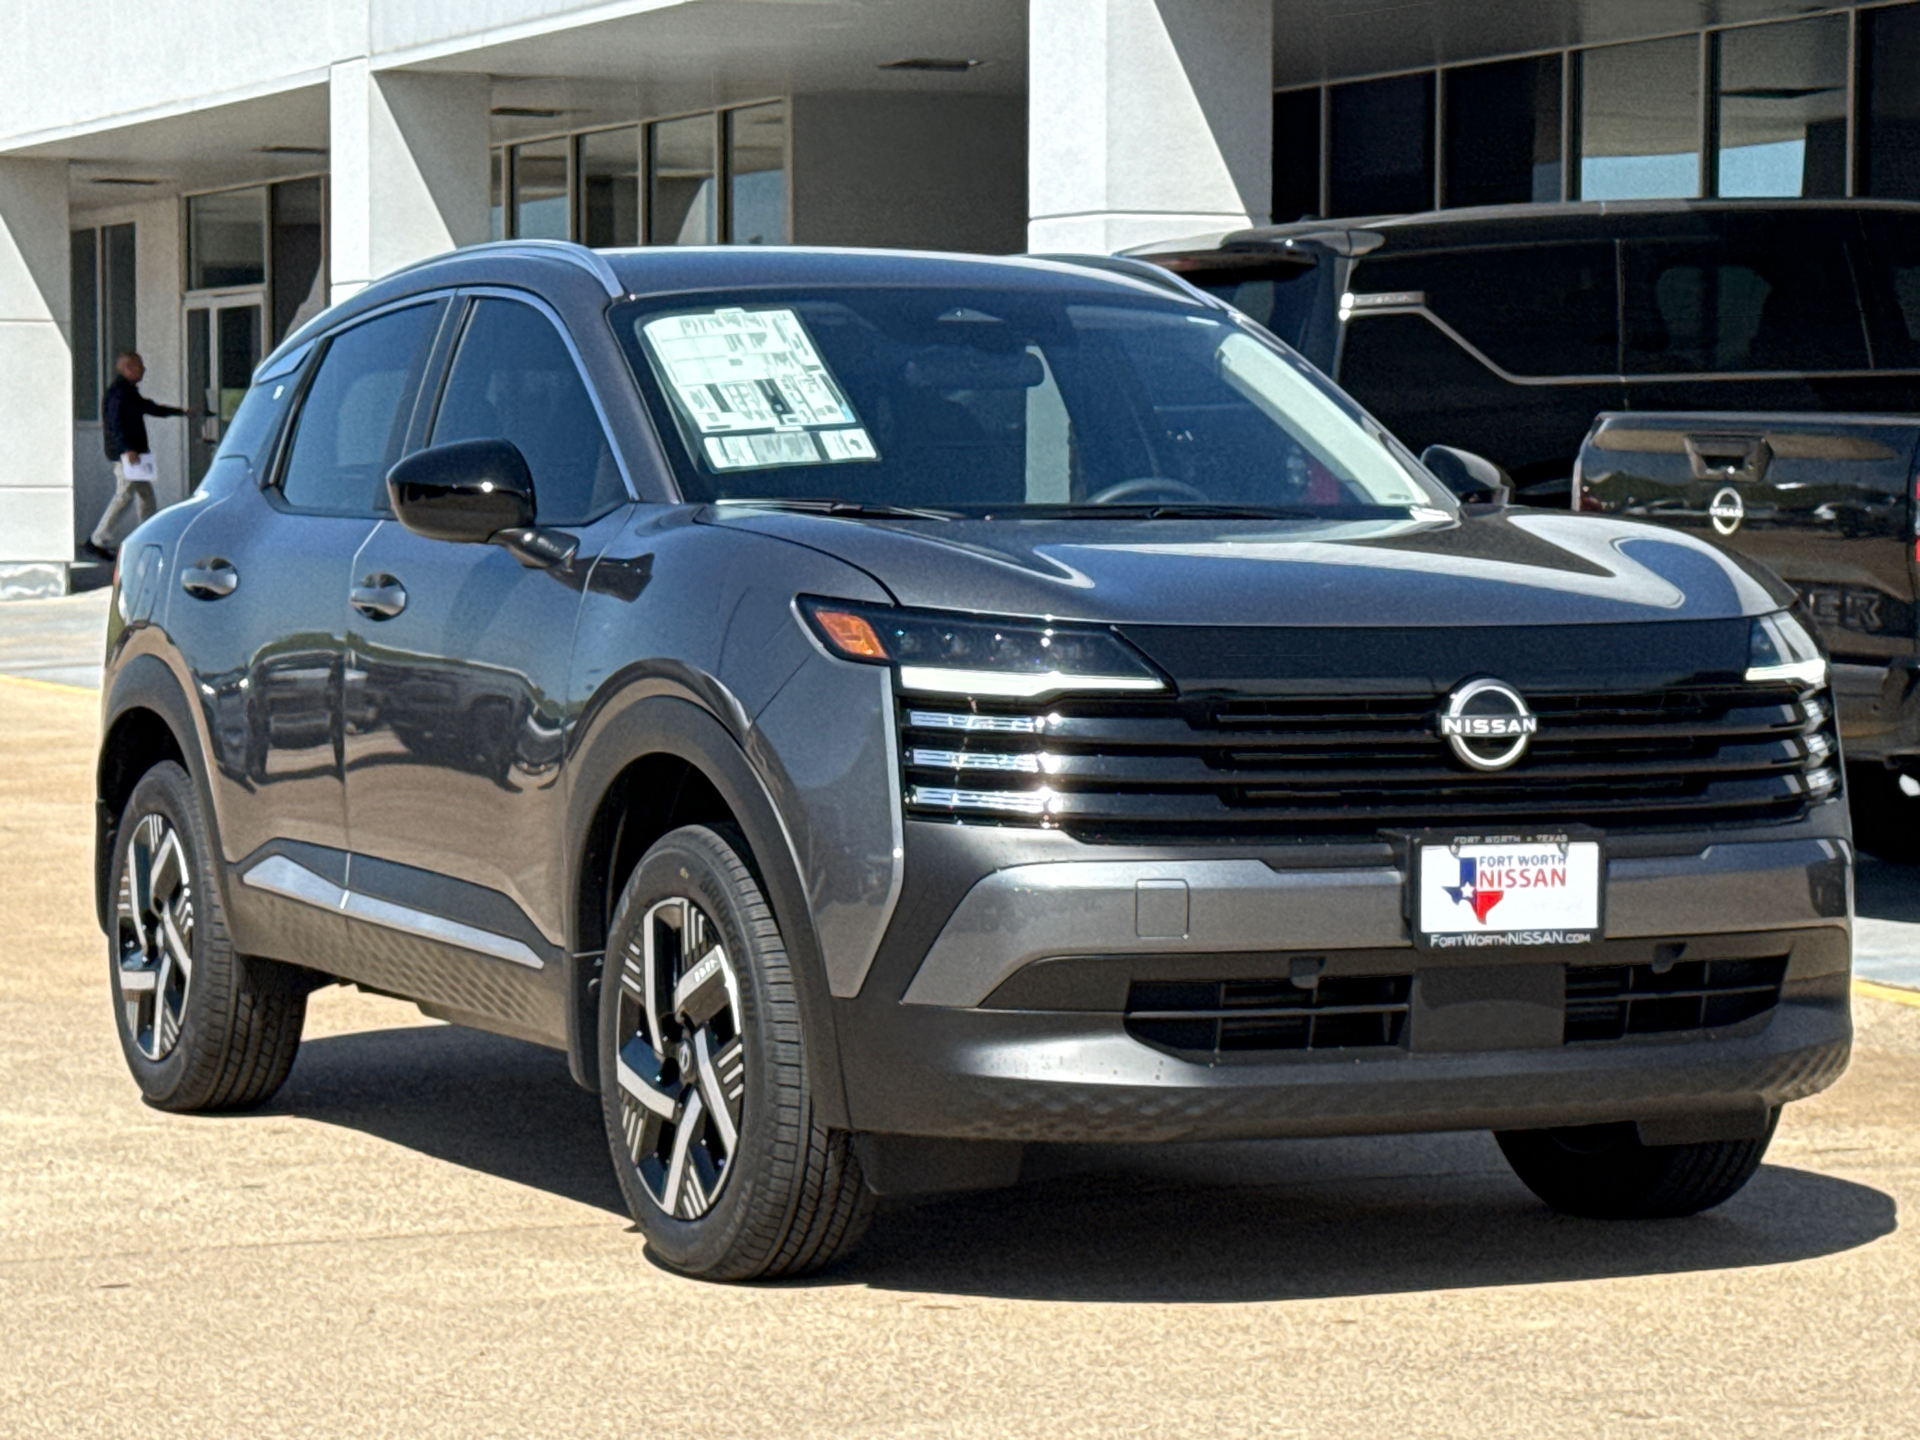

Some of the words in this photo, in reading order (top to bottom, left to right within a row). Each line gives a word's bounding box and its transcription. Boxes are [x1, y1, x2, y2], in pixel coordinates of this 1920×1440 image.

[1444, 718, 1537, 734] NISSAN
[1454, 835, 1481, 844] FORT
[1536, 833, 1568, 842] TEXAS
[1479, 855, 1513, 868] FORT
[1517, 854, 1566, 867] WORTH
[1479, 867, 1567, 888] NISSAN
